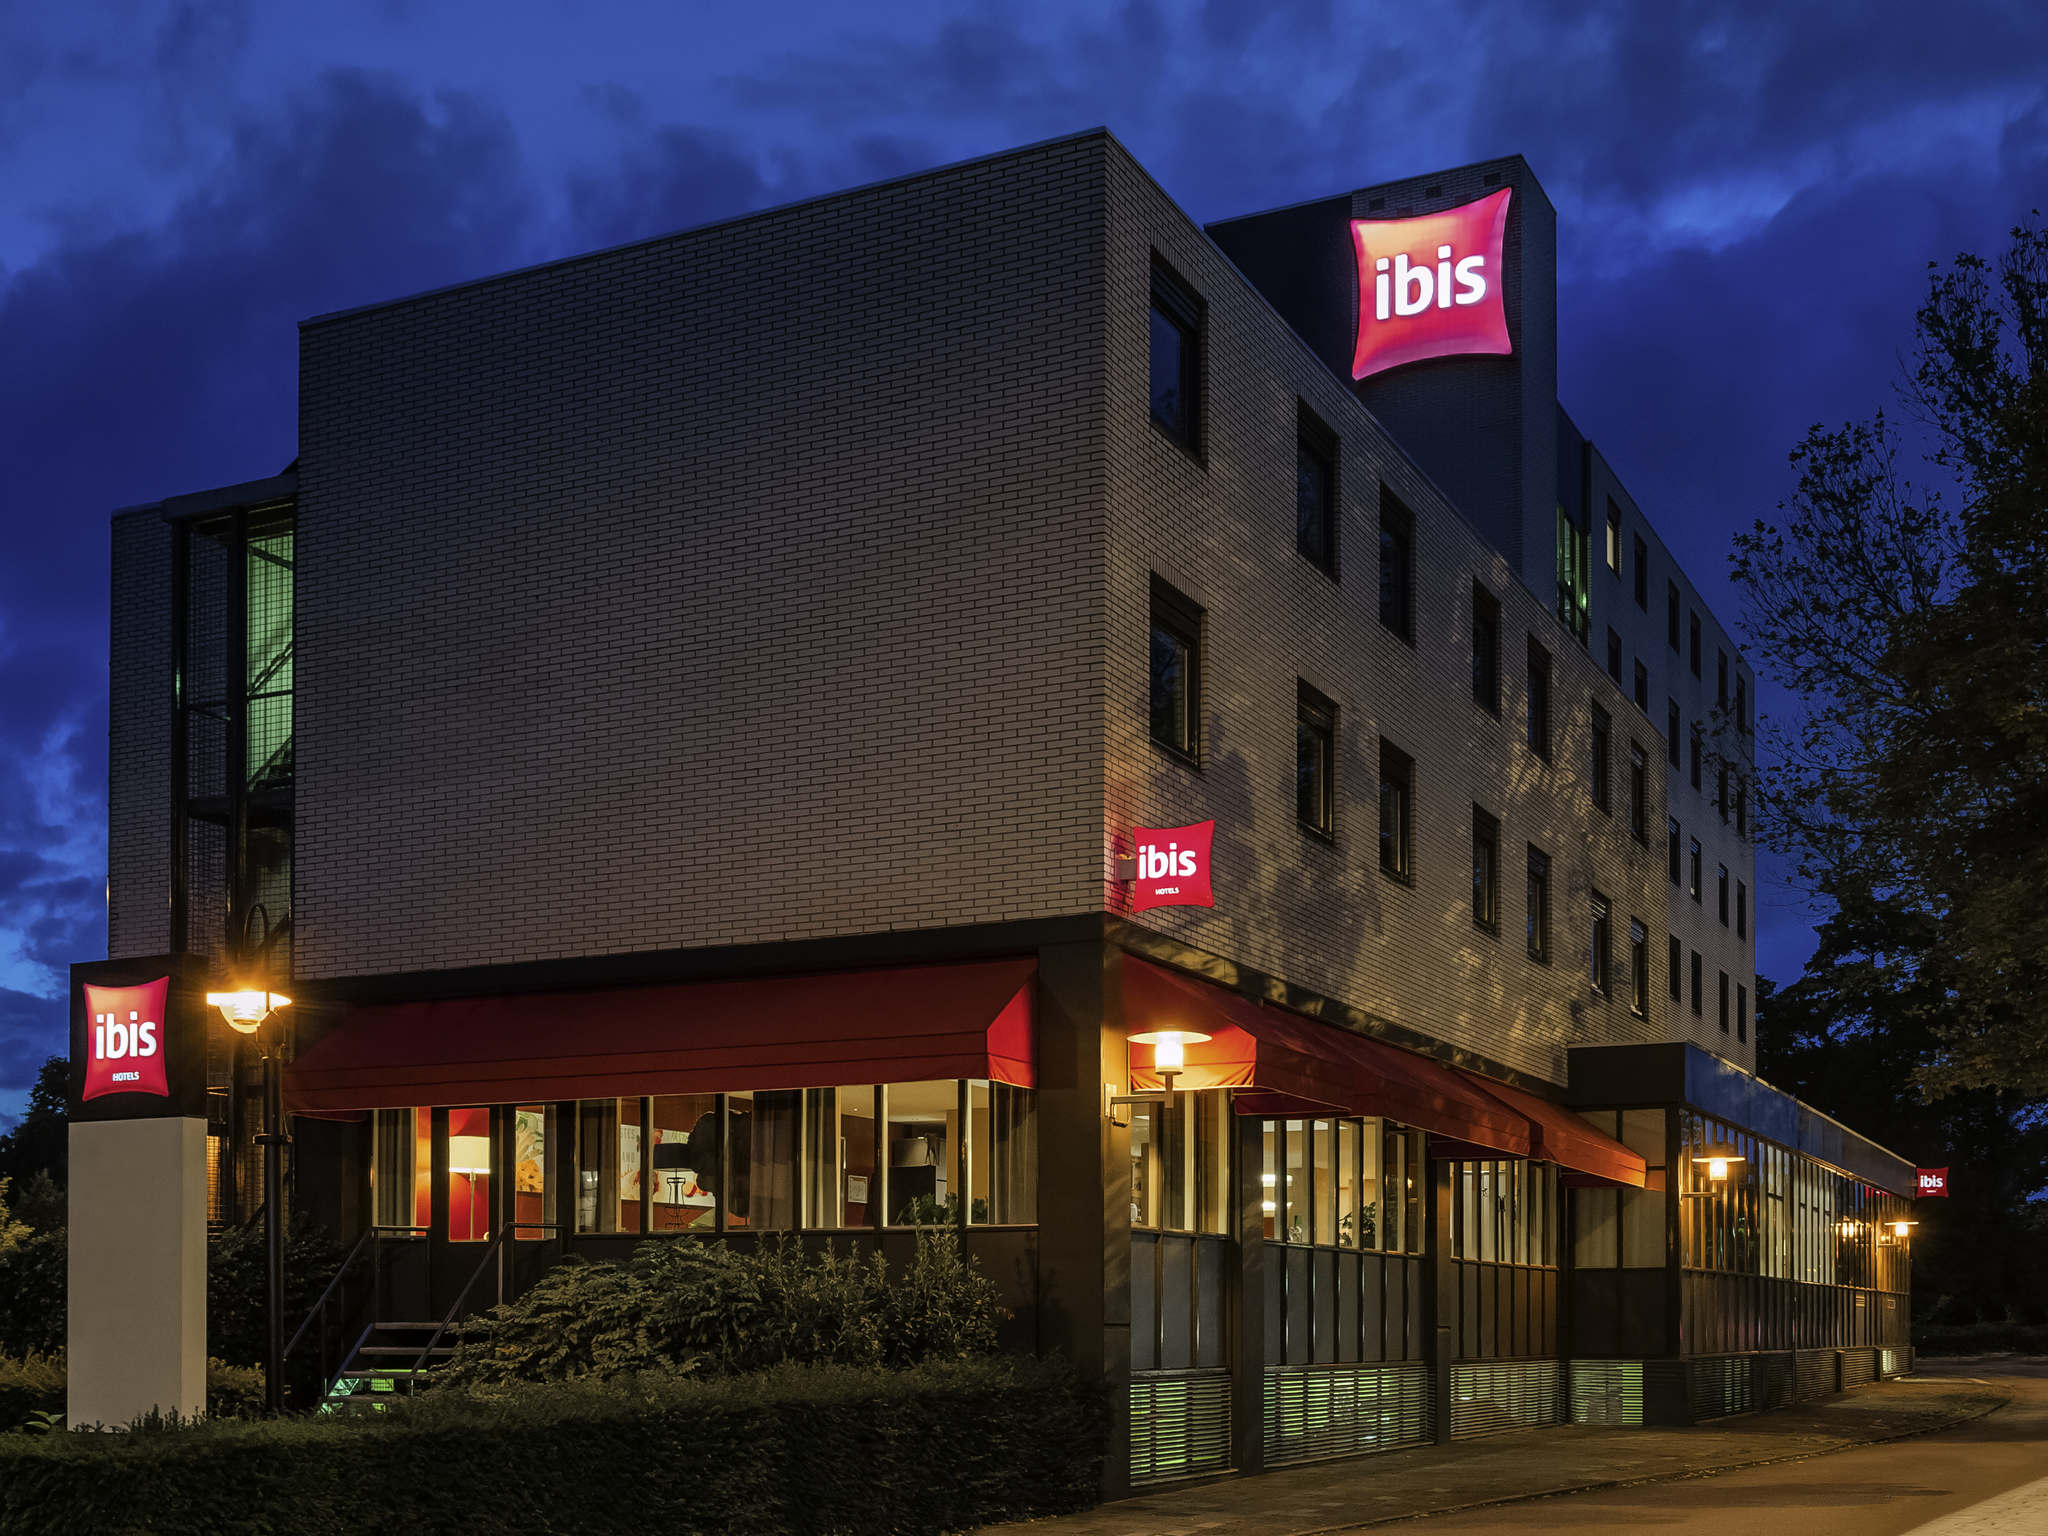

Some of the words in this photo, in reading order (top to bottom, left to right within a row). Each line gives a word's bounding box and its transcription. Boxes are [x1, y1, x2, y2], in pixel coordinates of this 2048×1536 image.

[1375, 244, 1487, 321] ibis
[1138, 842, 1197, 880] ibis
[1154, 886, 1180, 896] HOTELS
[95, 1010, 157, 1060] ibis
[112, 1071, 140, 1082] HOTELS
[1919, 1175, 1944, 1188] ibis
